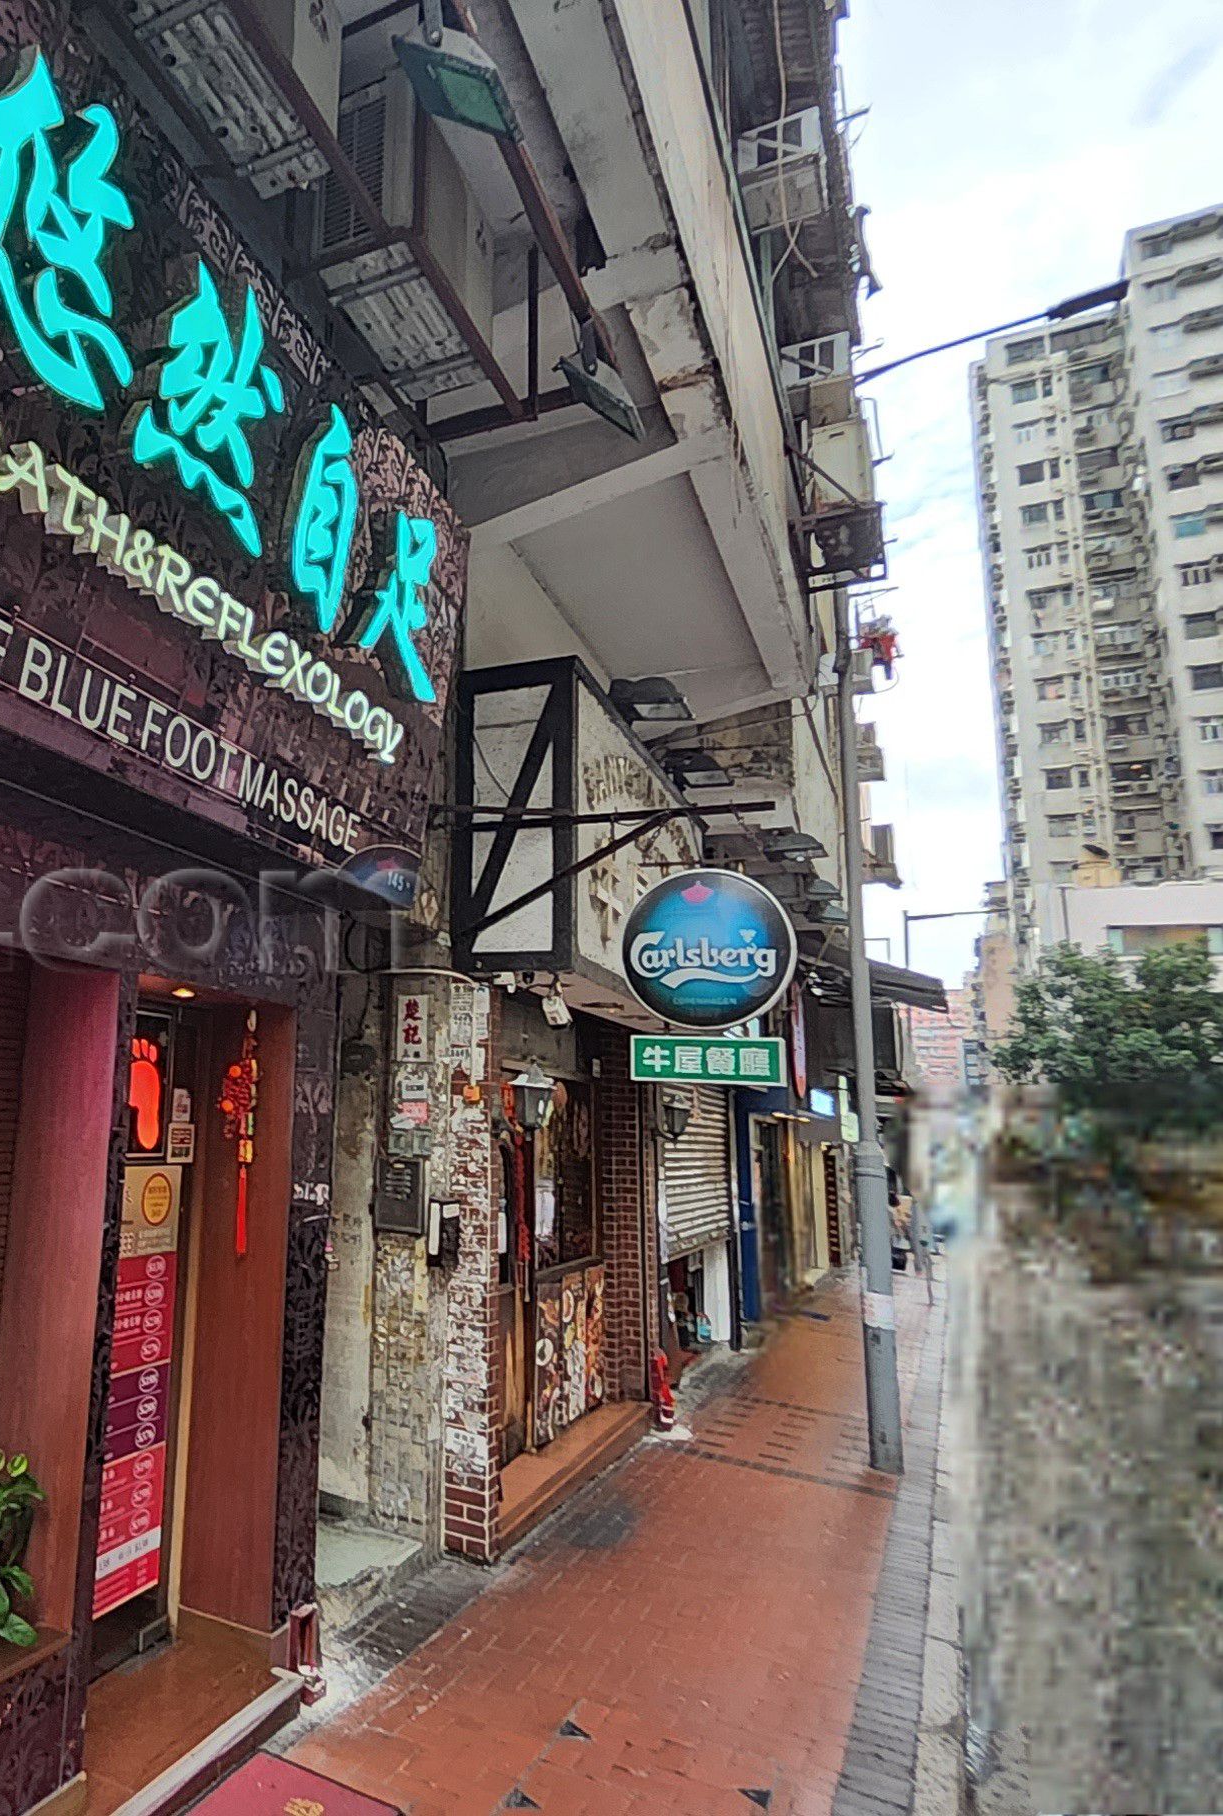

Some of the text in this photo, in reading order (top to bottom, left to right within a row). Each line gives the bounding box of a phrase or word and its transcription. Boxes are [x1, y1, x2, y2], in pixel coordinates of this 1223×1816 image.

[19, 637, 141, 744] BLUE
[141, 703, 238, 790] FOOT
[238, 757, 361, 855] MASSAGE
[630, 929, 776, 979] Carlsberg
[641, 1045, 771, 1077] 牛屋餐廳
